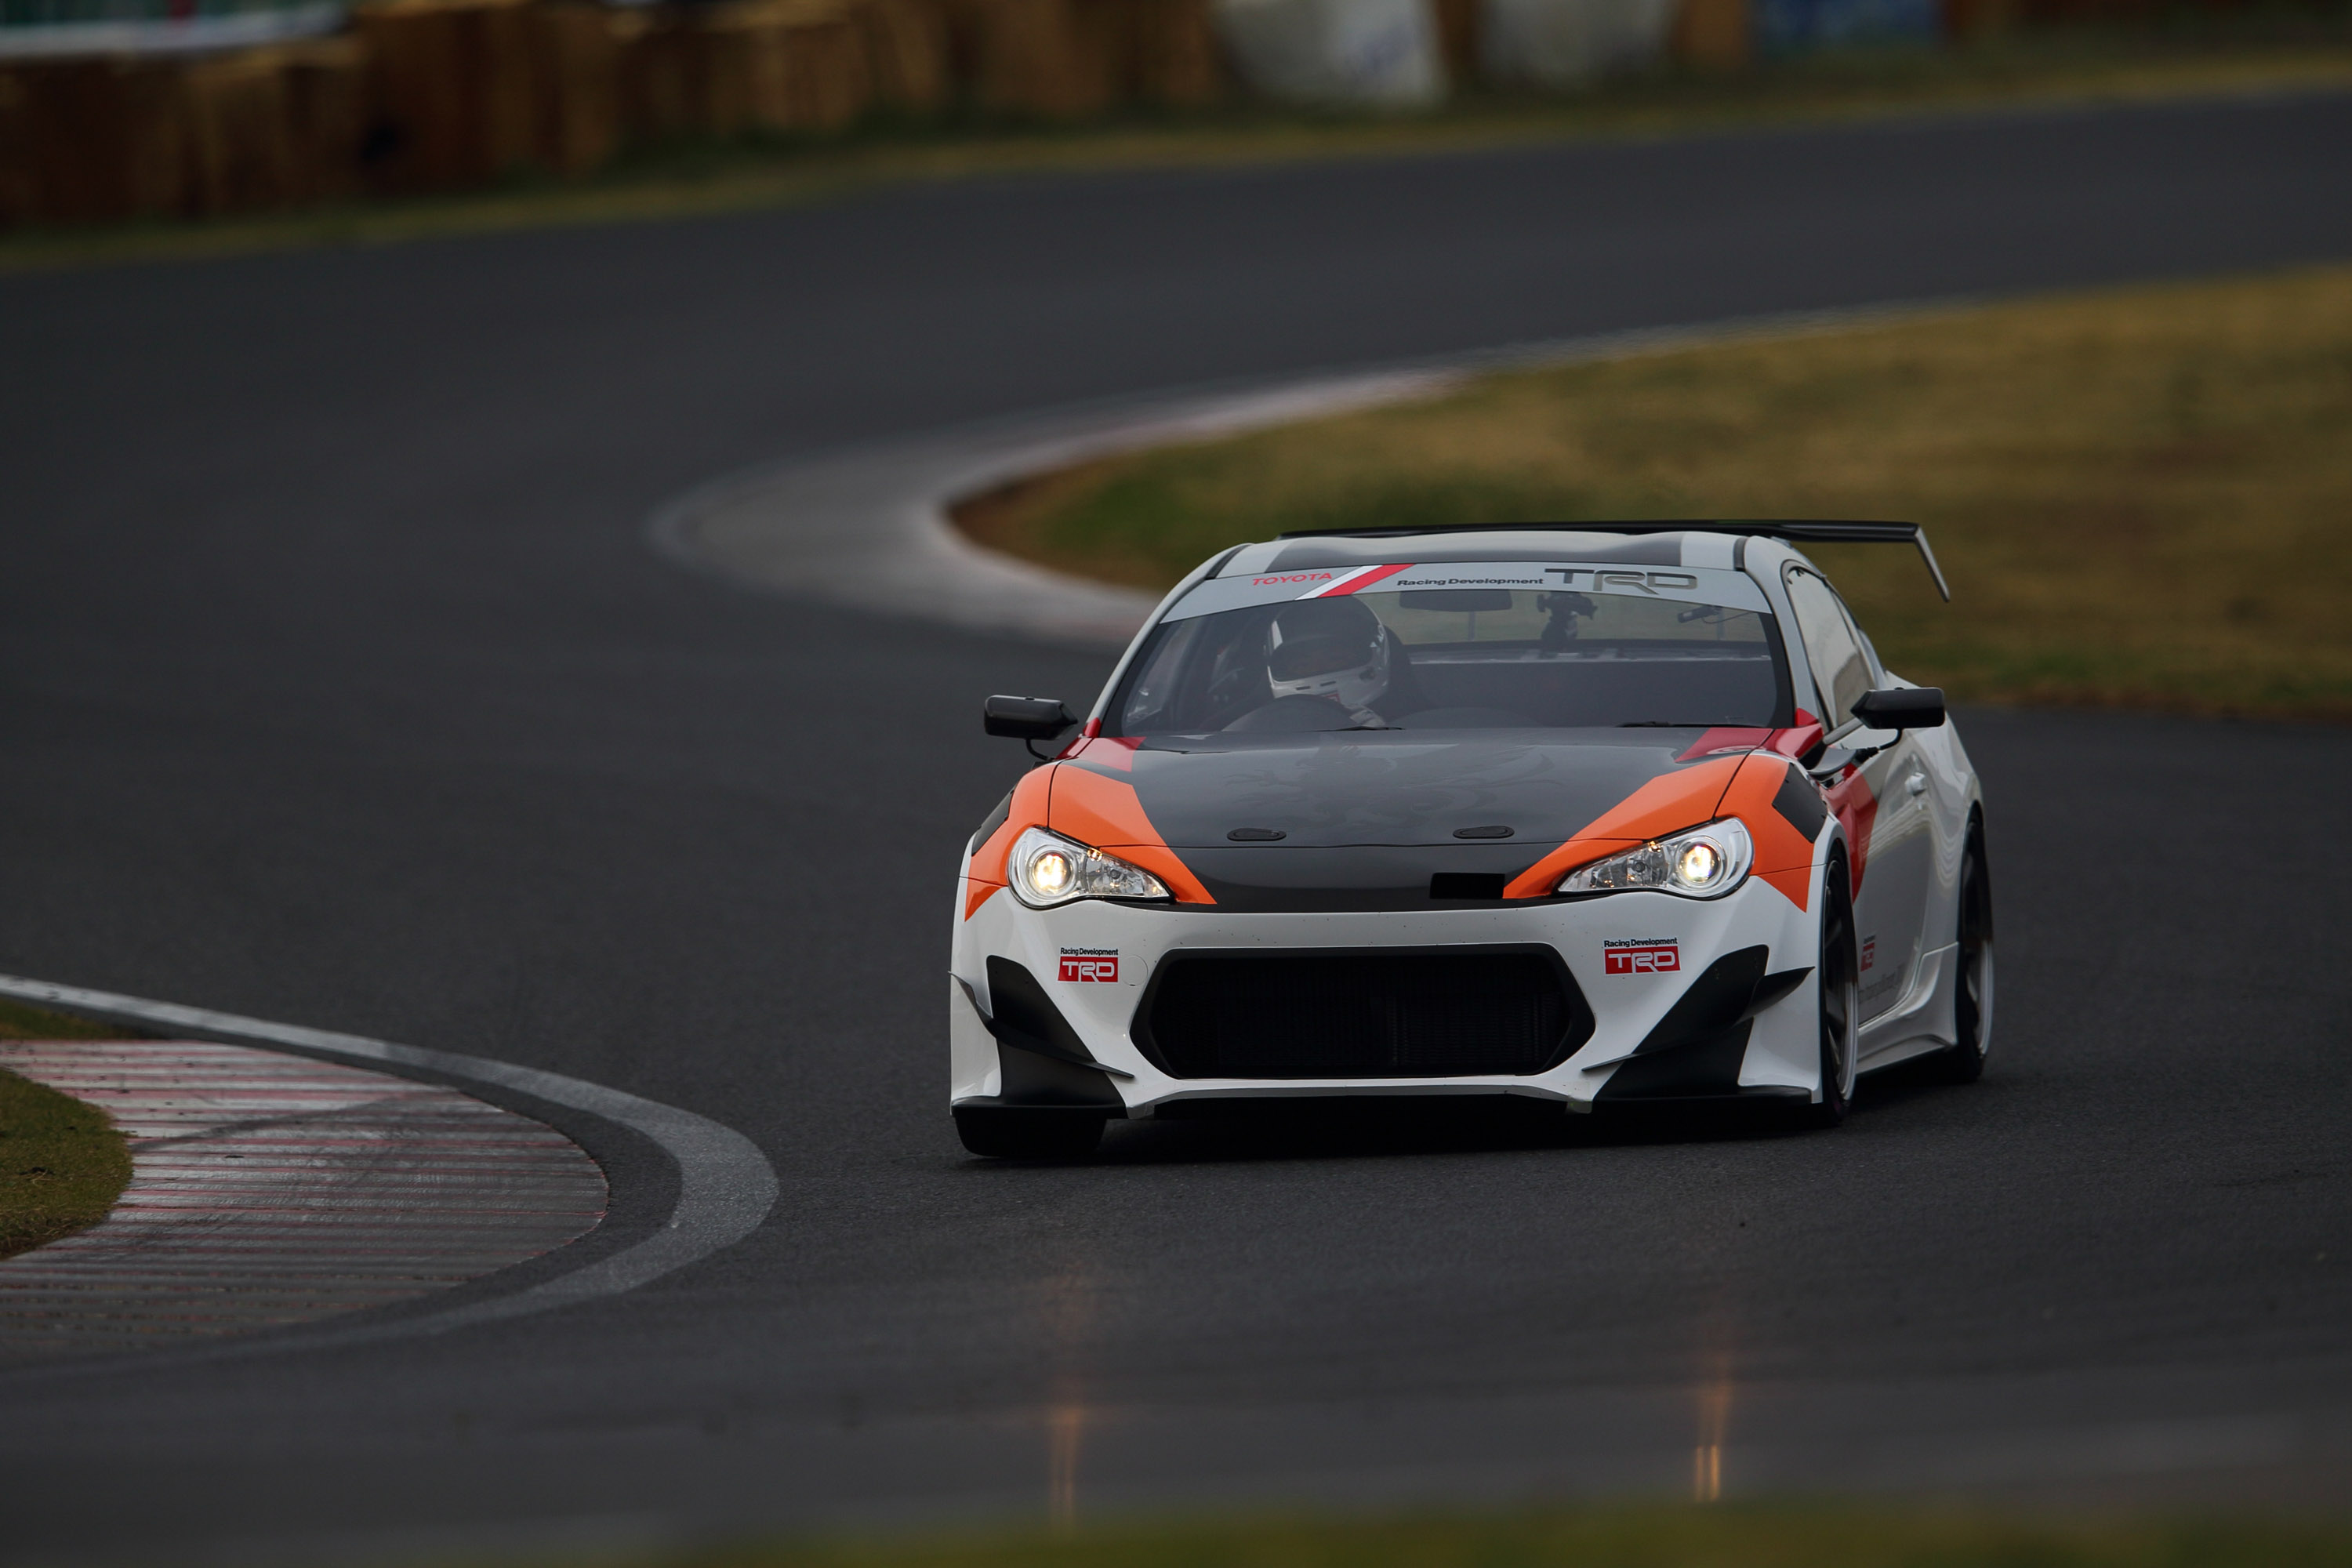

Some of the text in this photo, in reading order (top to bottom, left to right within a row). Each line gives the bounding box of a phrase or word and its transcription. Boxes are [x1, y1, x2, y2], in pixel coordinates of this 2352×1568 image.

[1252, 572, 1332, 586] TOYOTA
[1544, 568, 1698, 595] TRD
[1061, 947, 1079, 956] Racing
[1608, 951, 1675, 973] TRD
[1062, 961, 1115, 982] TRD
